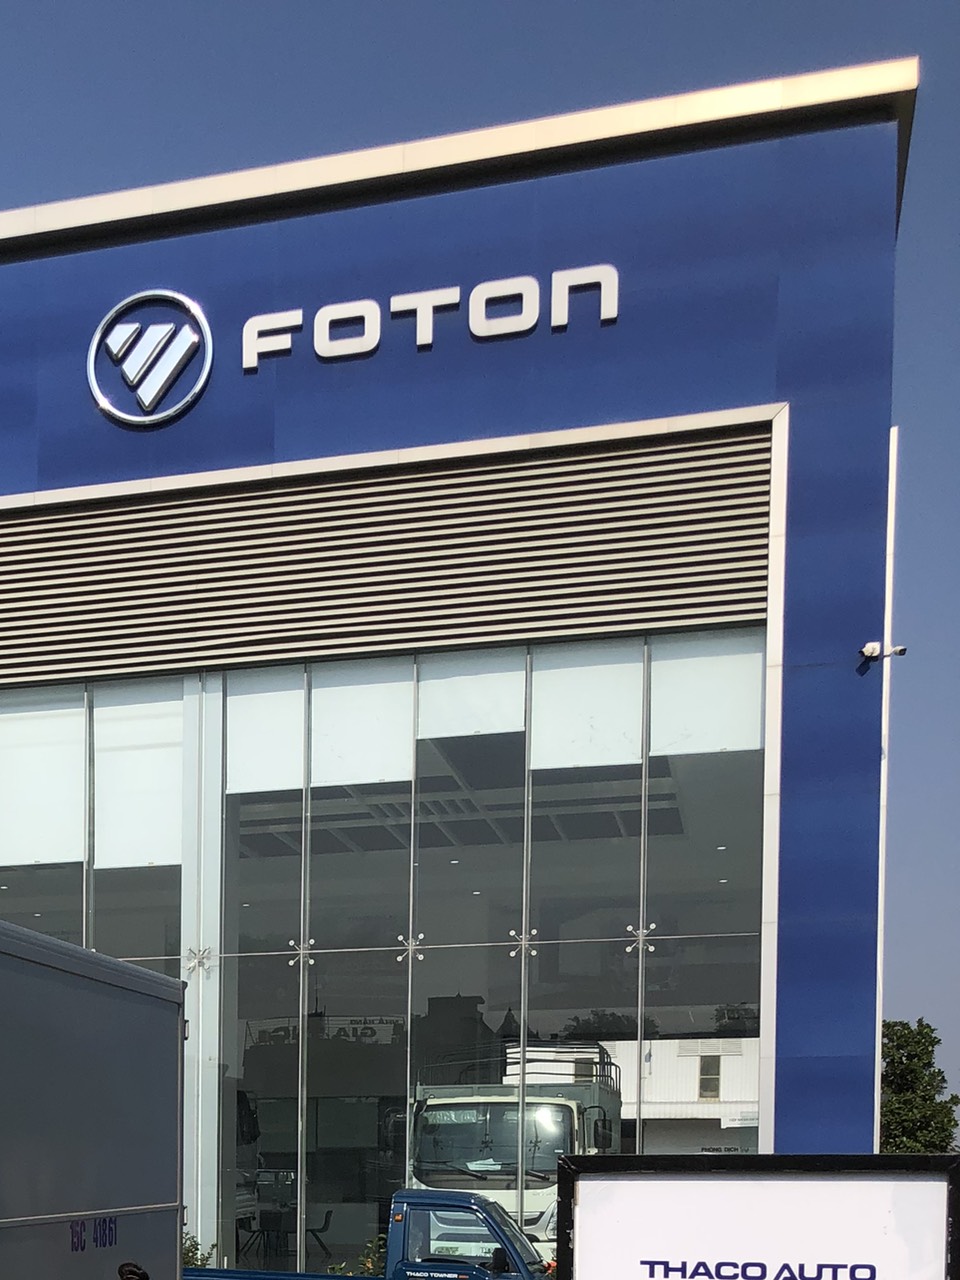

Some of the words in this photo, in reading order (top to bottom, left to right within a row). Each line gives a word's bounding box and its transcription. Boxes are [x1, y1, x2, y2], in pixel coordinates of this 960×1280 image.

[242, 264, 619, 370] FOTON
[69, 1219, 86, 1252] 15C
[92, 1217, 118, 1248] 41861
[640, 1260, 767, 1280] THACO
